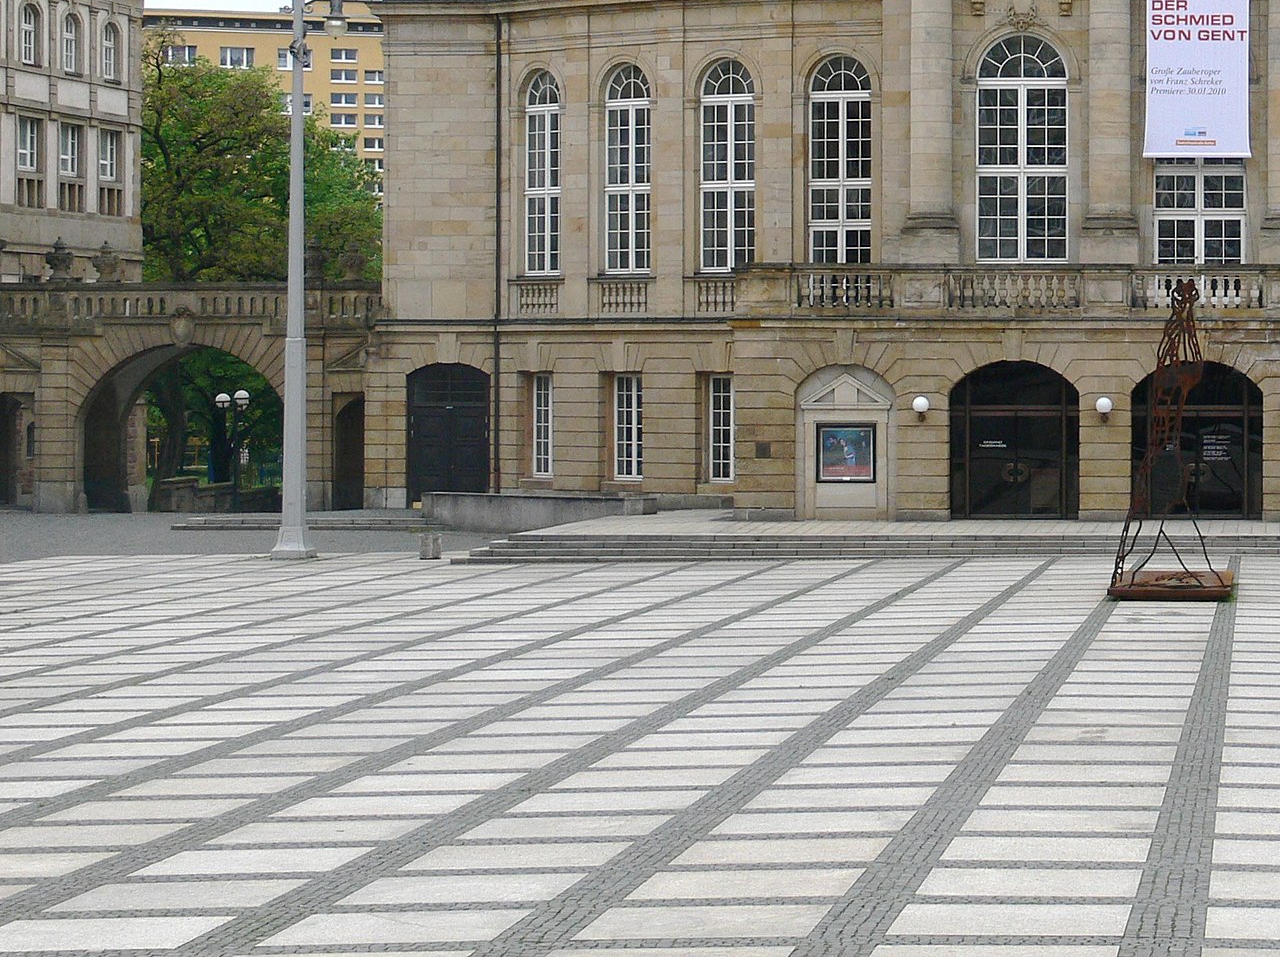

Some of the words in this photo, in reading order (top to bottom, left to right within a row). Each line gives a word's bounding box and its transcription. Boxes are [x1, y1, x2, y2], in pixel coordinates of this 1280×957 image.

[1151, 0, 1188, 11] DER
[1151, 14, 1234, 26] SCHMIED
[1150, 29, 1191, 41] VON
[1197, 30, 1247, 41] GENT
[1151, 67, 1174, 76] Große
[1176, 67, 1222, 77] Zauberoper
[1190, 77, 1223, 85] Schreker
[1150, 87, 1186, 95] Premiere:
[1187, 87, 1227, 95] 30.01.2010
